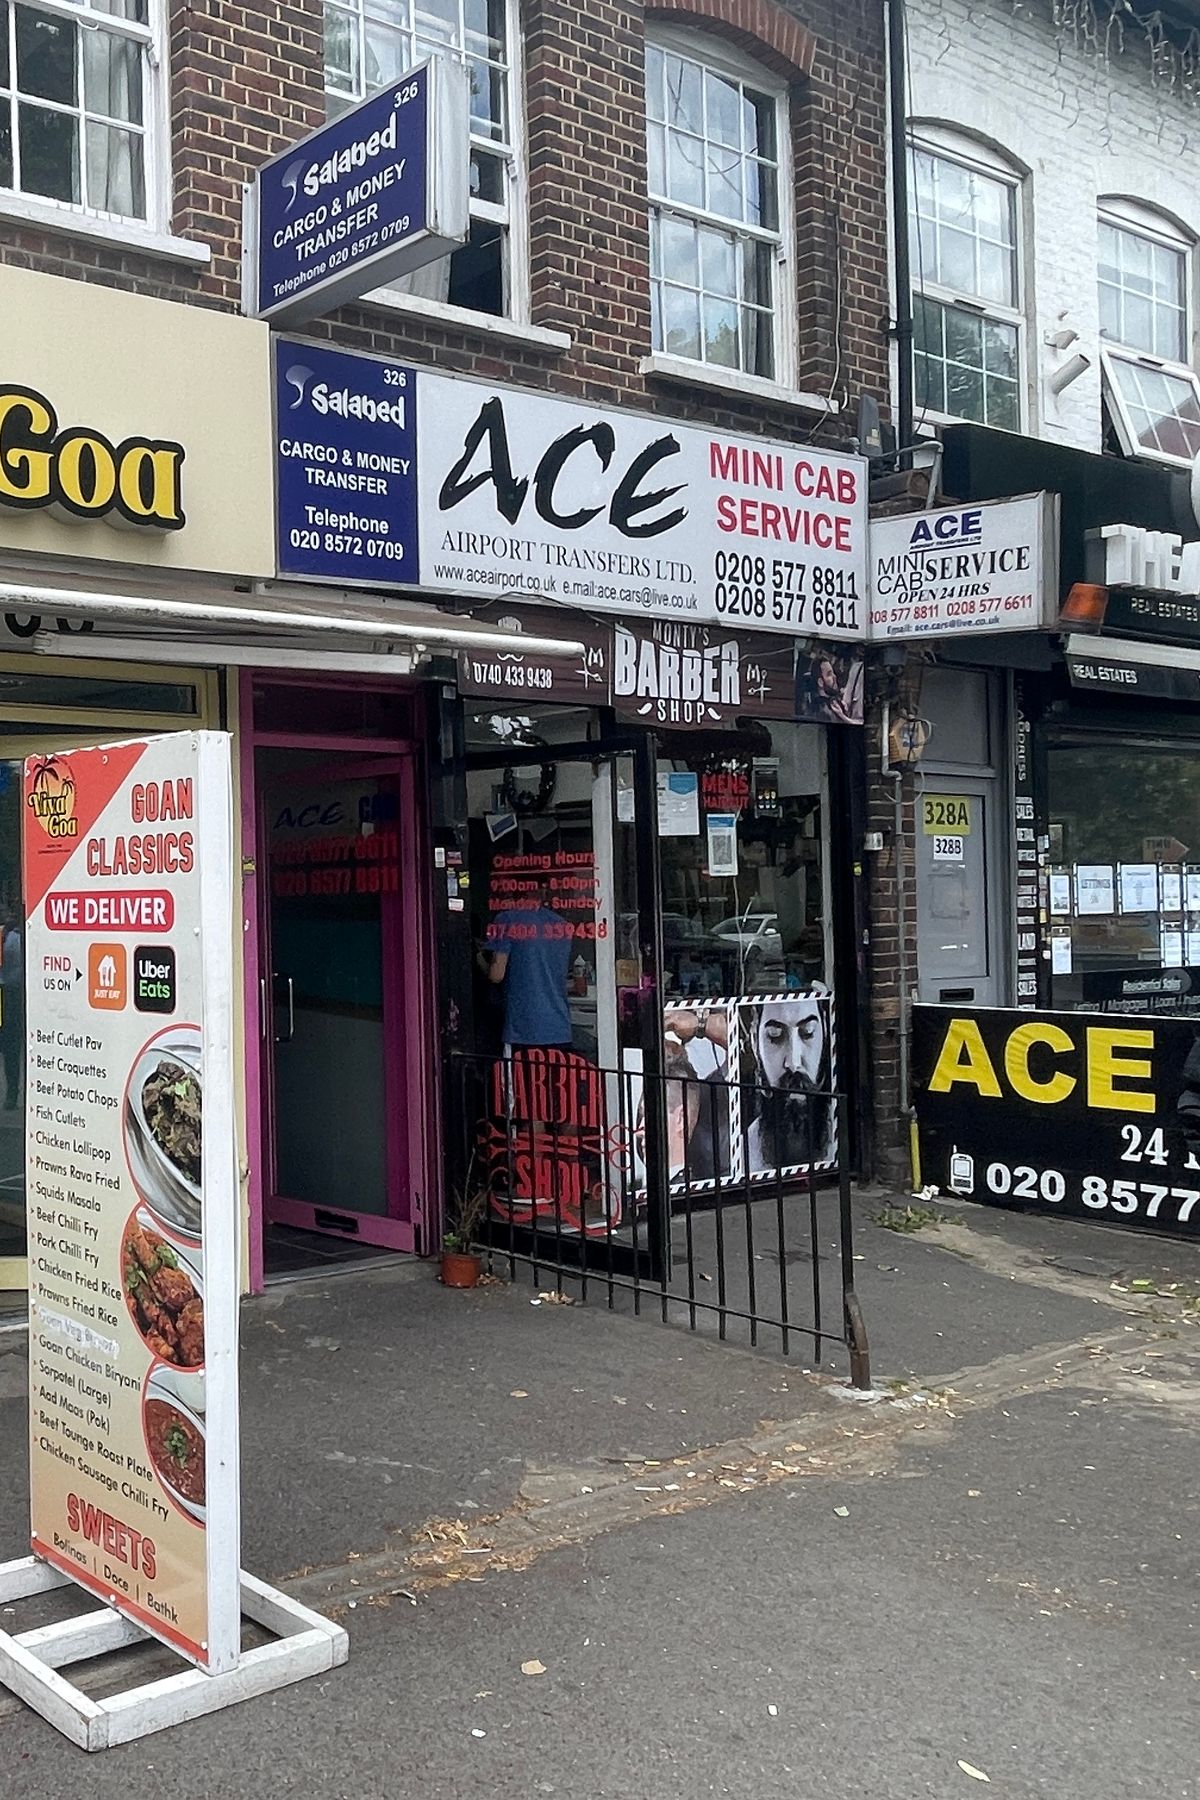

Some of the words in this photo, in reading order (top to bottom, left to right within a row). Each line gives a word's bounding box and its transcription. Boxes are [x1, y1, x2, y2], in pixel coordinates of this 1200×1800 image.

[393, 81, 418, 109] 326
[303, 111, 397, 197] Salabed
[272, 205, 328, 249] CARGO
[330, 197, 342, 217] &
[345, 158, 406, 210] MONEY
[295, 202, 379, 262] TRANSFER
[272, 261, 327, 297] Telephone
[328, 247, 349, 269] 020
[350, 231, 379, 258] 8572
[380, 215, 410, 241] 0709
[383, 368, 407, 387] 326
[311, 383, 406, 430] Salabed
[279, 439, 338, 464] CARGO
[342, 450, 353, 467] &
[356, 452, 411, 476] MONEY
[438, 395, 689, 539] ACE
[304, 467, 389, 496] TRANSFER
[709, 441, 784, 492] MINI
[793, 459, 858, 506] CAB
[304, 505, 390, 535] Telephone
[716, 494, 852, 553] SERVICE
[909, 510, 983, 544] ACE
[290, 529, 320, 550] 020
[324, 533, 363, 556] 8572
[366, 538, 405, 560] 0709
[440, 530, 537, 562] AIRPORT
[541, 541, 651, 579] TRANSFERS
[654, 563, 698, 586] LTD.
[433, 563, 557, 593] www.aceairport.co.uk
[715, 549, 765, 586] 0208
[771, 558, 808, 592] 577
[811, 565, 860, 600] 8811
[878, 552, 926, 577] MINI
[925, 545, 1031, 582] SERVICE
[876, 571, 924, 596] CAB
[897, 586, 940, 605] OPEN
[939, 586, 956, 600] 24
[957, 582, 991, 597] HRS
[714, 582, 766, 617] 0208
[771, 589, 808, 624] 577
[812, 596, 860, 630] 6611
[890, 607, 911, 622] 577
[913, 604, 939, 620] 8811
[947, 600, 976, 618] 0208
[979, 597, 1001, 614] 577
[1003, 594, 1033, 611] 6611
[1158, 602, 1199, 622] ESTATES
[652, 621, 711, 646] MONTY'S
[505, 666, 525, 686] 433
[527, 667, 553, 689] 9438
[613, 629, 741, 706] BARBER
[1072, 663, 1098, 680] REAL
[1098, 667, 1138, 684] ESTATES
[657, 699, 706, 724] SHOP
[702, 773, 749, 794] MENS
[28, 791, 67, 818] Viva
[130, 777, 194, 824] GOAN
[273, 801, 346, 830] ACE
[924, 801, 969, 826] 328A
[47, 815, 78, 839] Goa
[86, 831, 194, 877] CLASSICS
[492, 852, 551, 869] Opening
[934, 838, 962, 854] 328B
[50, 898, 79, 924] WE
[83, 897, 167, 926] DELIVER
[551, 896, 603, 910] Sunday
[43, 956, 72, 972] FIND
[138, 959, 171, 980] Uber
[43, 979, 56, 990] US
[57, 979, 71, 991] ON
[138, 979, 171, 999] Eats
[36, 1028, 55, 1045] Beef
[57, 1032, 84, 1049] Cutlet
[85, 1036, 103, 1051] Pav
[36, 1055, 55, 1070] Beef
[57, 1058, 108, 1079] Croquettes
[927, 1018, 1157, 1114] ACE
[36, 1080, 55, 1095] Beef
[56, 1083, 85, 1102] Potato
[87, 1089, 119, 1110] Chops
[35, 1105, 54, 1121] Fish
[55, 1109, 87, 1129] Cutlets
[35, 1131, 71, 1151] Chicken
[73, 1139, 112, 1164] Lollipop
[1120, 1124, 1170, 1166] 24
[35, 1156, 68, 1178] Prawns
[69, 1164, 93, 1184] Rava
[95, 1170, 121, 1191] Fried
[35, 1181, 65, 1202] Squids
[67, 1190, 102, 1213] Masala
[985, 1162, 1067, 1203] 020
[1080, 1174, 1200, 1223] 8577
[36, 1206, 56, 1224] Beef
[57, 1211, 82, 1232] Chilli
[83, 1224, 99, 1242] Fry
[58, 1238, 83, 1258] Chilli
[84, 1250, 100, 1269] Fry
[37, 1257, 73, 1283] Chicken
[74, 1268, 100, 1290] Fried
[100, 1276, 122, 1300] Rice
[38, 1281, 71, 1305] Prawns
[72, 1293, 97, 1318] Fried
[97, 1306, 119, 1328] Rice
[38, 1334, 64, 1358] Goan
[65, 1345, 104, 1375] Chicken
[104, 1362, 142, 1393] Biryani
[38, 1384, 59, 1405] Aad
[77, 1377, 113, 1410] (Large)
[38, 1409, 60, 1432] Beef
[97, 1439, 125, 1469] Roast
[126, 1454, 154, 1484] Plate
[38, 1434, 77, 1469] Chicken
[77, 1454, 119, 1494] Sausage
[121, 1478, 150, 1510] Chilli
[151, 1496, 170, 1523] Fry
[66, 1491, 157, 1582] SWEETS
